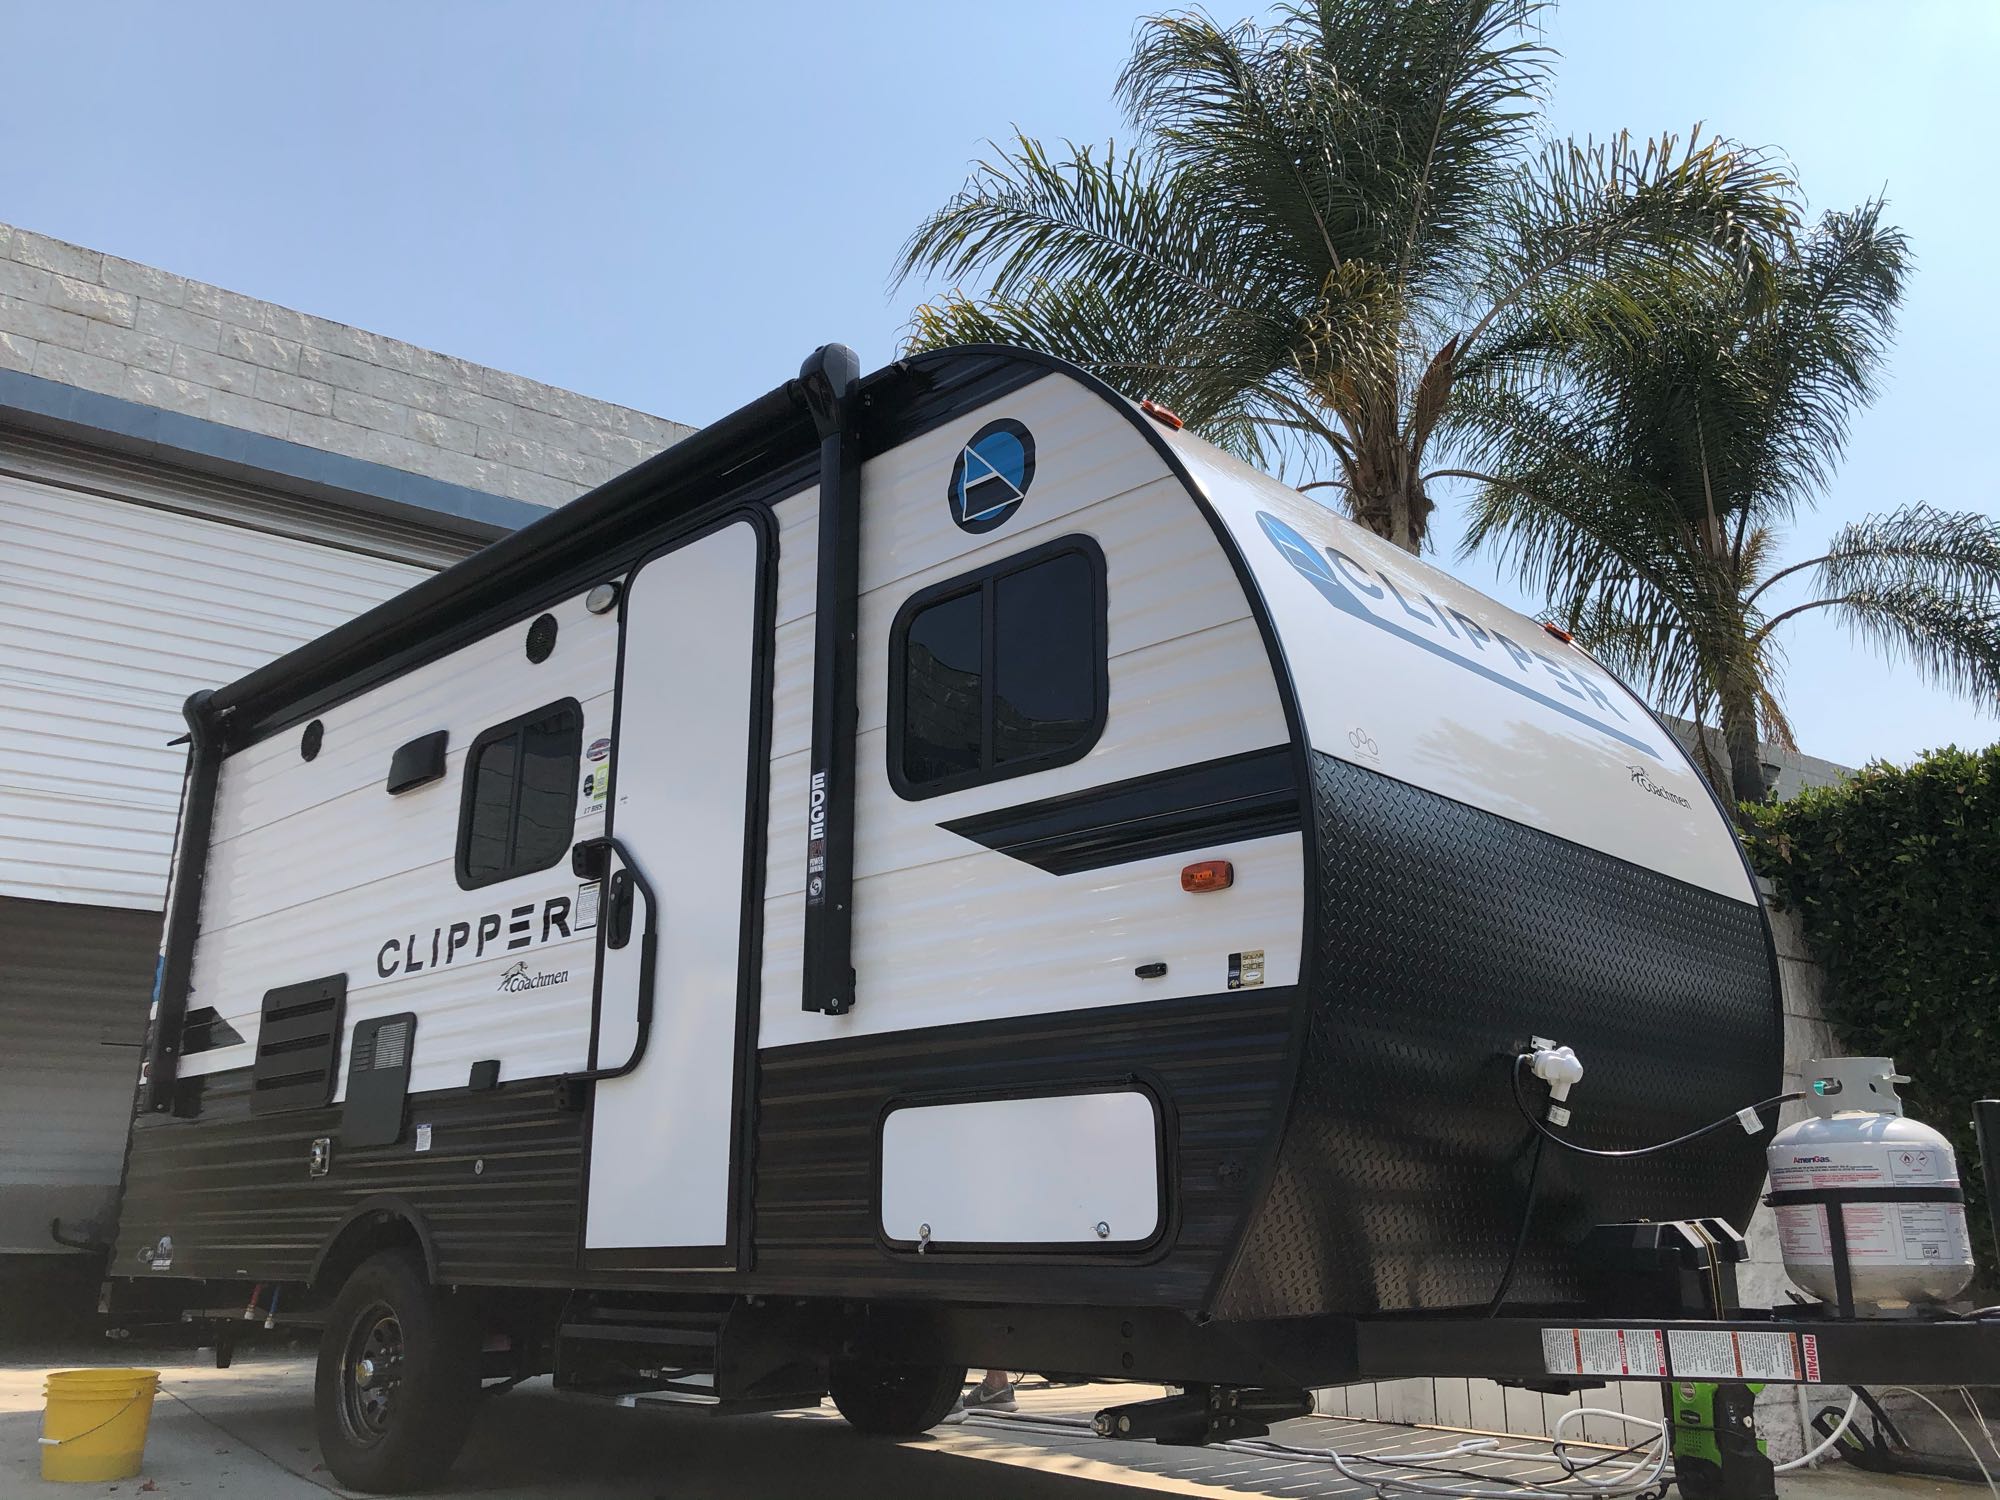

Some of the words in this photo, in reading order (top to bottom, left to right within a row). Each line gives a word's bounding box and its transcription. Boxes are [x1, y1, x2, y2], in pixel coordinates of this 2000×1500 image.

[1325, 546, 1630, 723] CLIPPER
[810, 772, 825, 841] EDGE
[1641, 777, 1692, 811] Coachmen
[377, 896, 571, 978] CLIPPER
[509, 970, 569, 993] Coachmen
[1619, 1342, 1628, 1367] DANGER
[1656, 1342, 1666, 1368] DANGER
[1804, 1336, 1819, 1381] PROPANE
